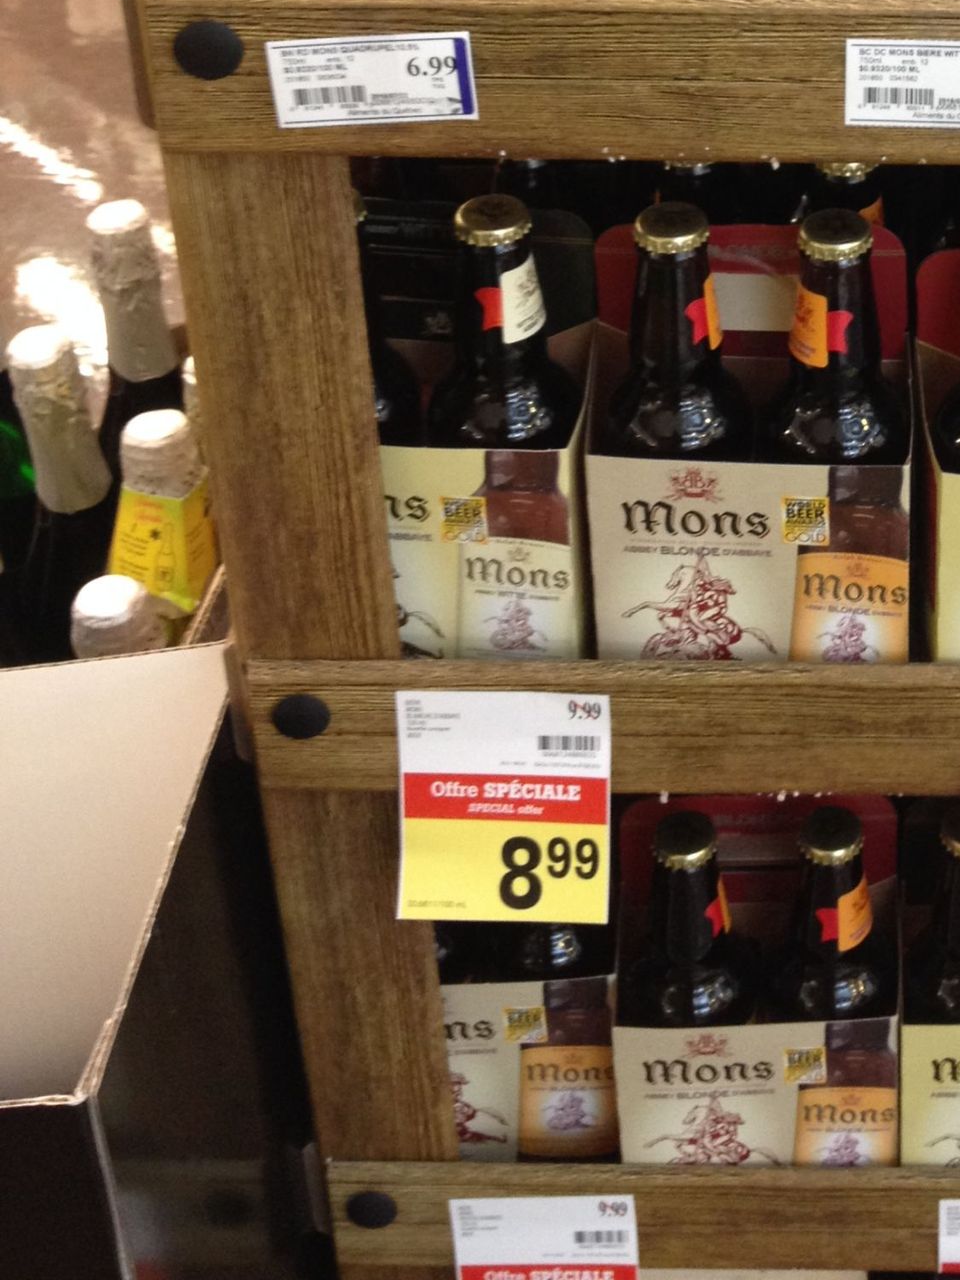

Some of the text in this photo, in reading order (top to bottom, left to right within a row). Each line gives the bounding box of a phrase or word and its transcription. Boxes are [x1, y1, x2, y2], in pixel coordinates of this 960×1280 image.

[889, 49, 914, 57] MONS
[406, 56, 457, 77] 6.99
[618, 499, 770, 539] Mons
[785, 508, 825, 520] BEER
[660, 544, 722, 557] BLONDE
[465, 553, 571, 591] Mons
[803, 572, 908, 606] Mons
[430, 779, 582, 801] Offre SPÉCIALE
[468, 803, 515, 814] SPECIAL
[643, 1059, 775, 1086] Mons
[804, 1103, 896, 1125] Mons
